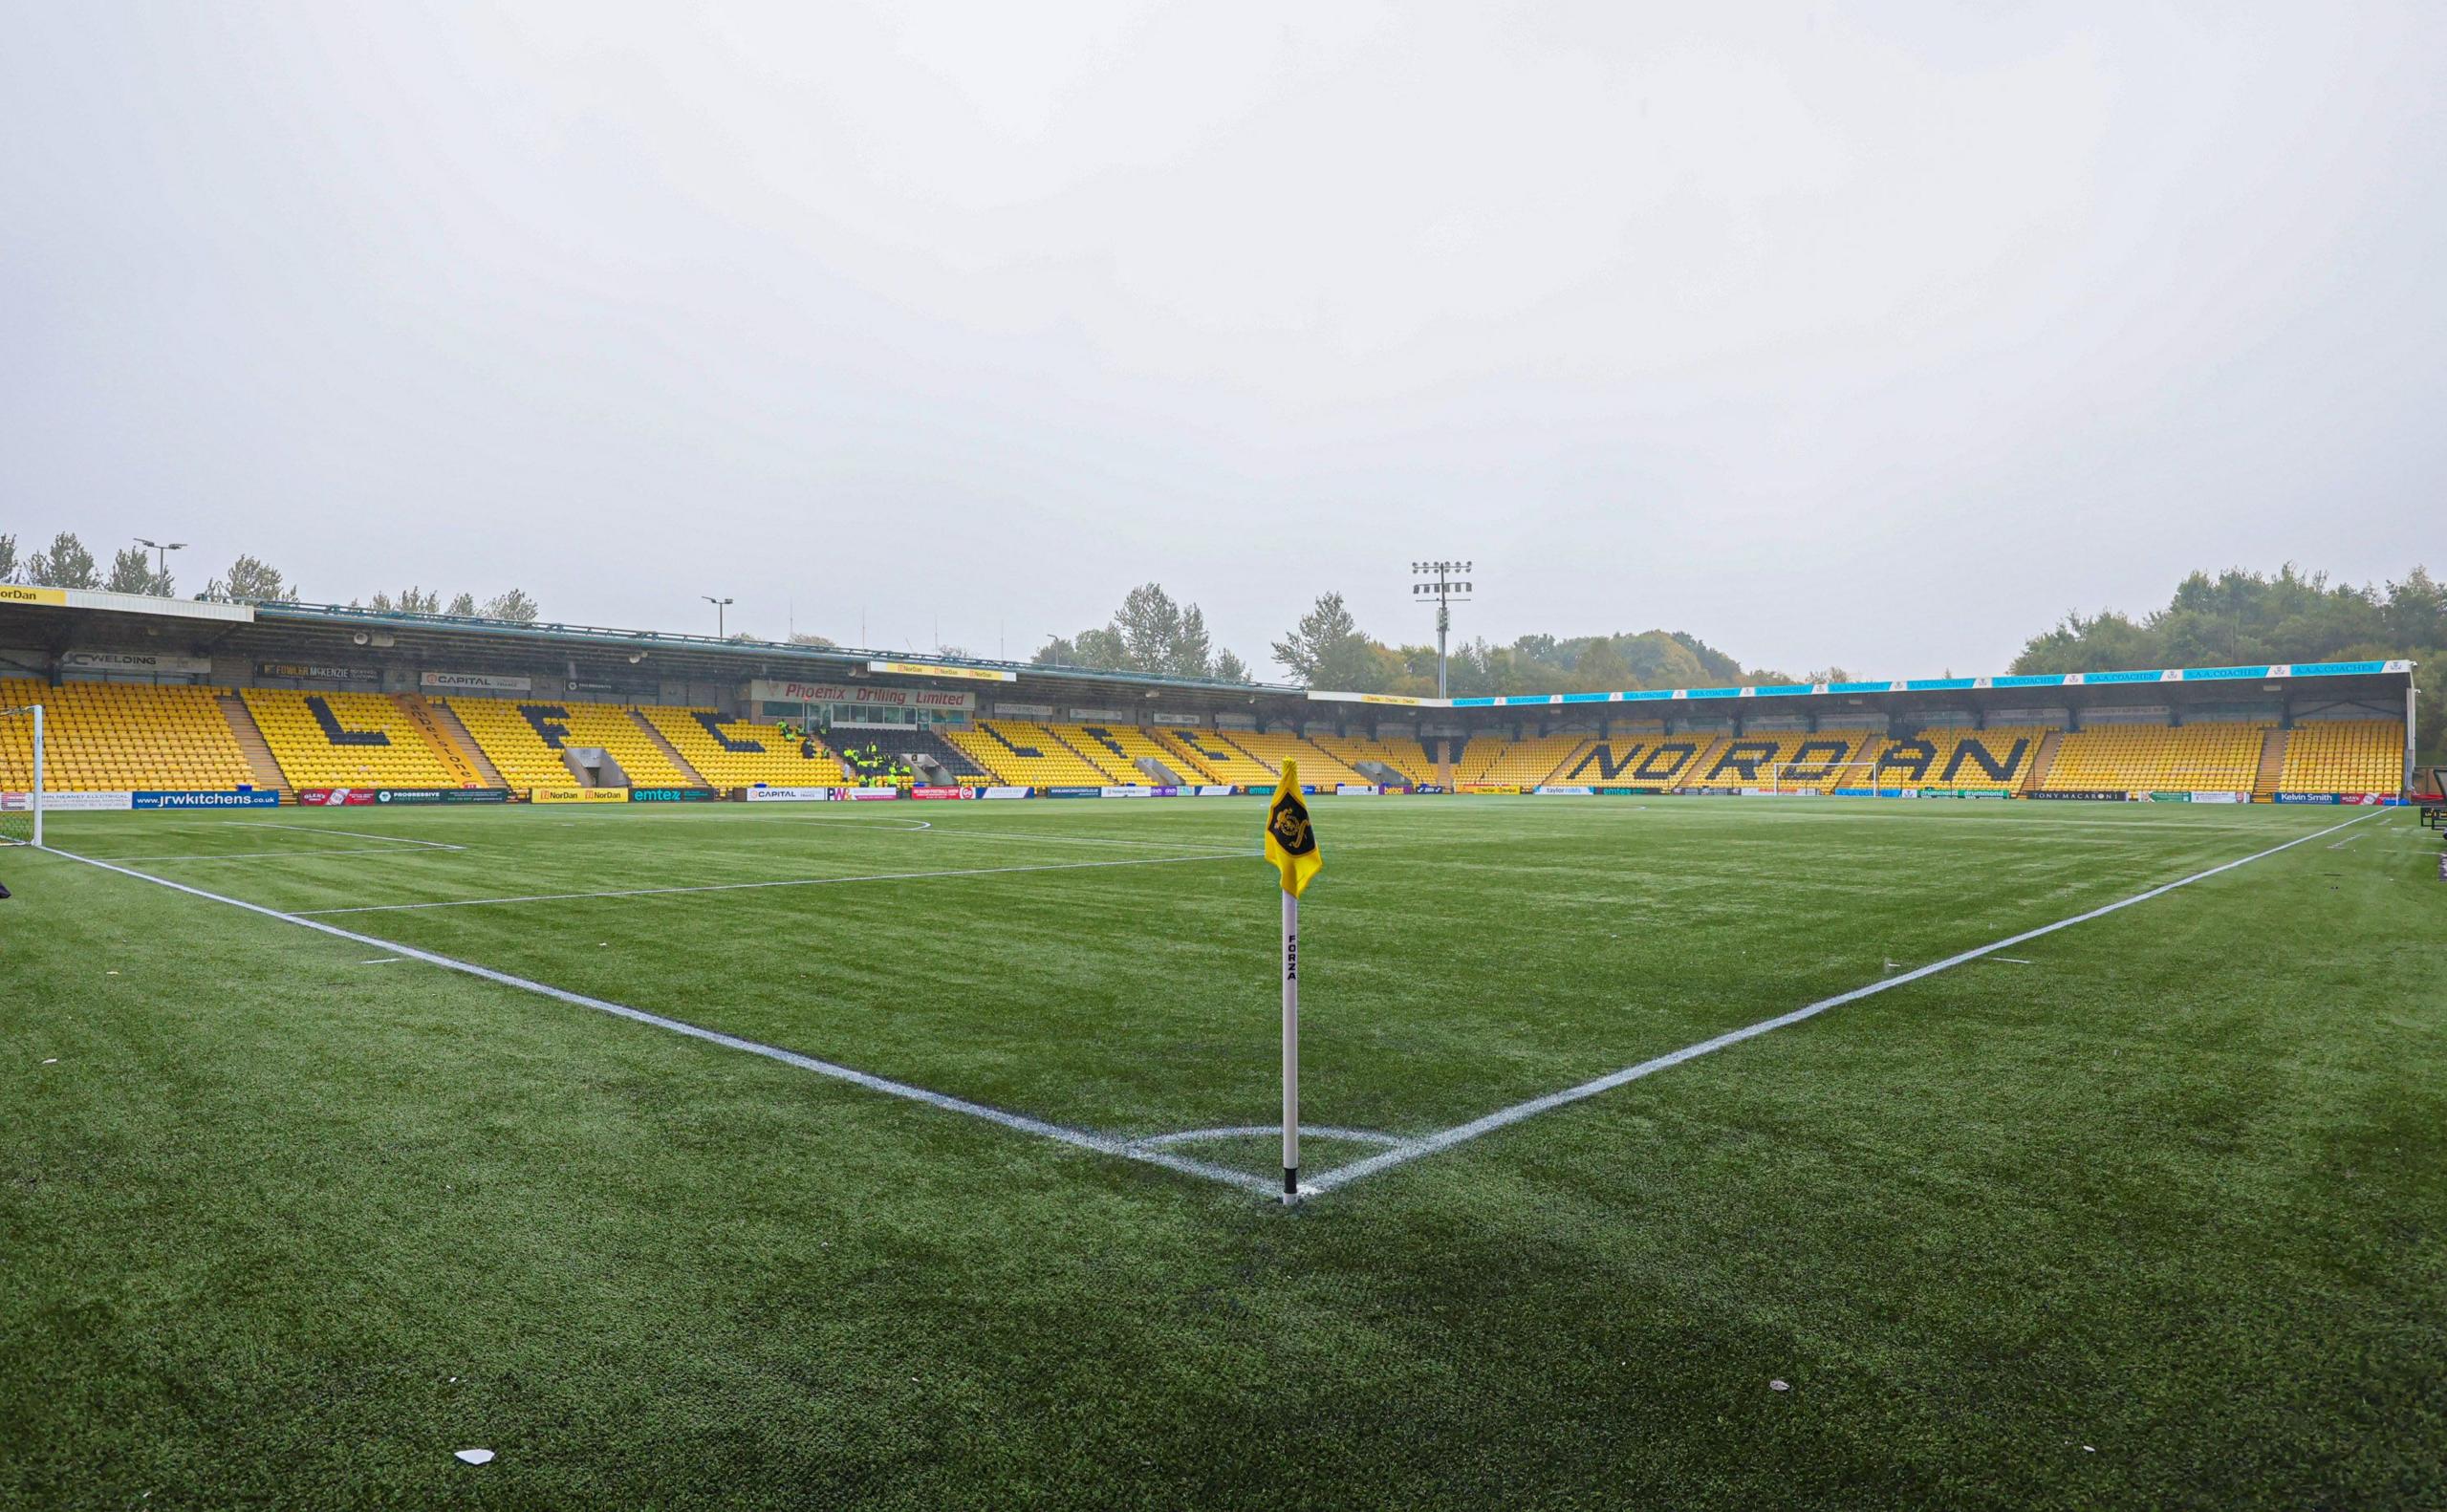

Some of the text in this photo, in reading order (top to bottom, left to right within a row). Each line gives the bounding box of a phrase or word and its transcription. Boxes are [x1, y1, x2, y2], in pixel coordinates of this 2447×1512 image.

[91, 655, 157, 665] WELDING
[438, 675, 491, 686] CAPITAL
[785, 682, 964, 705] Phoenix Drilling Limited
[137, 793, 275, 808] www.jrwkitchens.co.uk
[550, 791, 578, 800] NorDan
[634, 788, 682, 801] emtez
[2281, 792, 2333, 801] Kelvin Smith
[1288, 935, 1297, 981] FORZA
